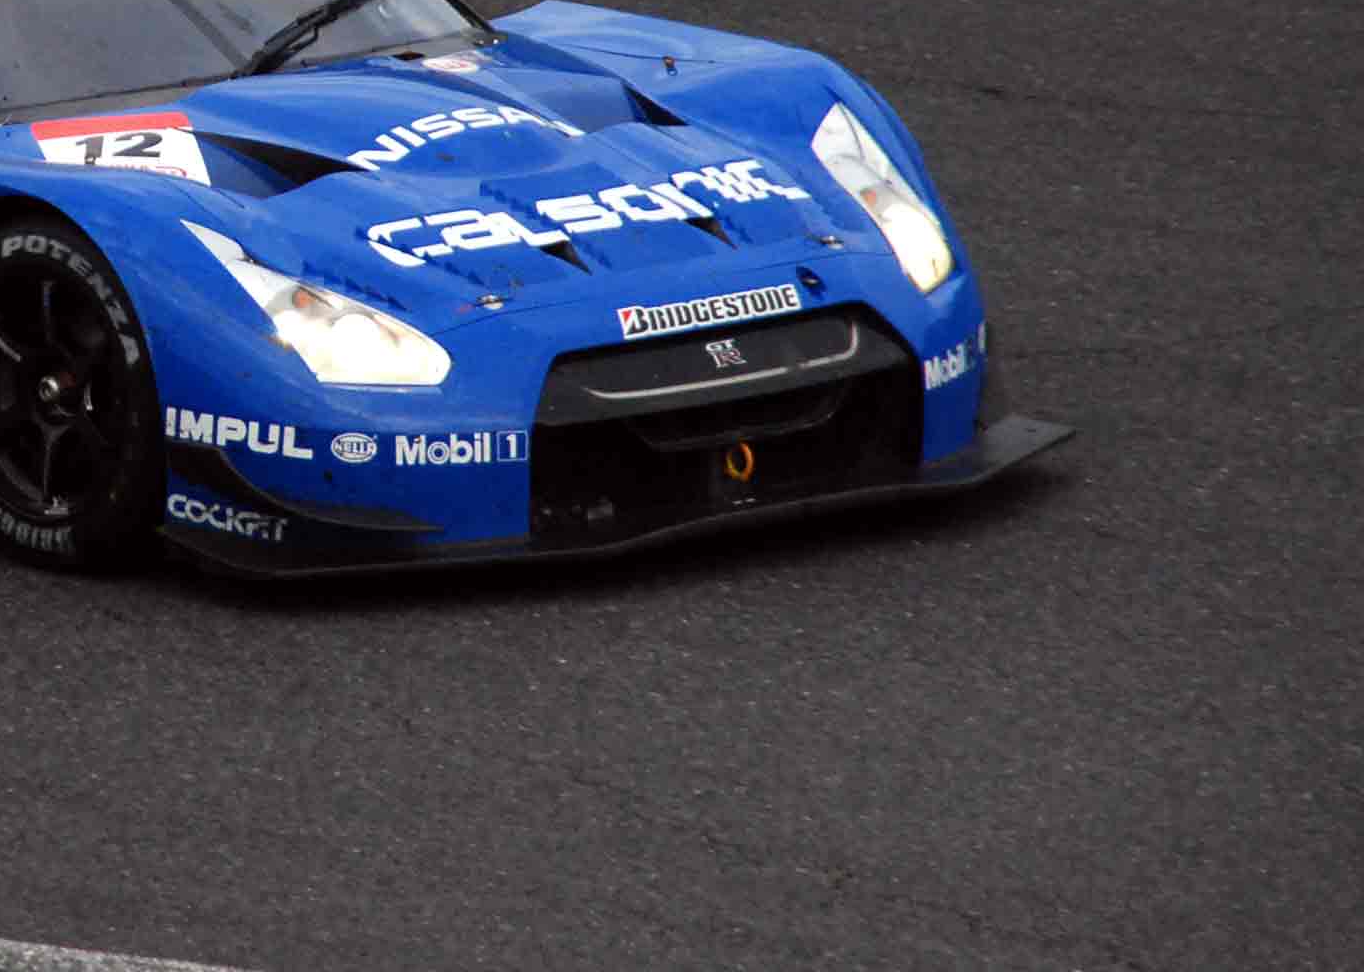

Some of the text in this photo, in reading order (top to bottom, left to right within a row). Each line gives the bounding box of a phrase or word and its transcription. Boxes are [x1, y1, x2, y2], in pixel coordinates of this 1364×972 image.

[75, 132, 163, 164] 12
[620, 283, 799, 339] BRIDGESTONE
[165, 407, 313, 460] IMPUL
[395, 433, 492, 466] Mobil
